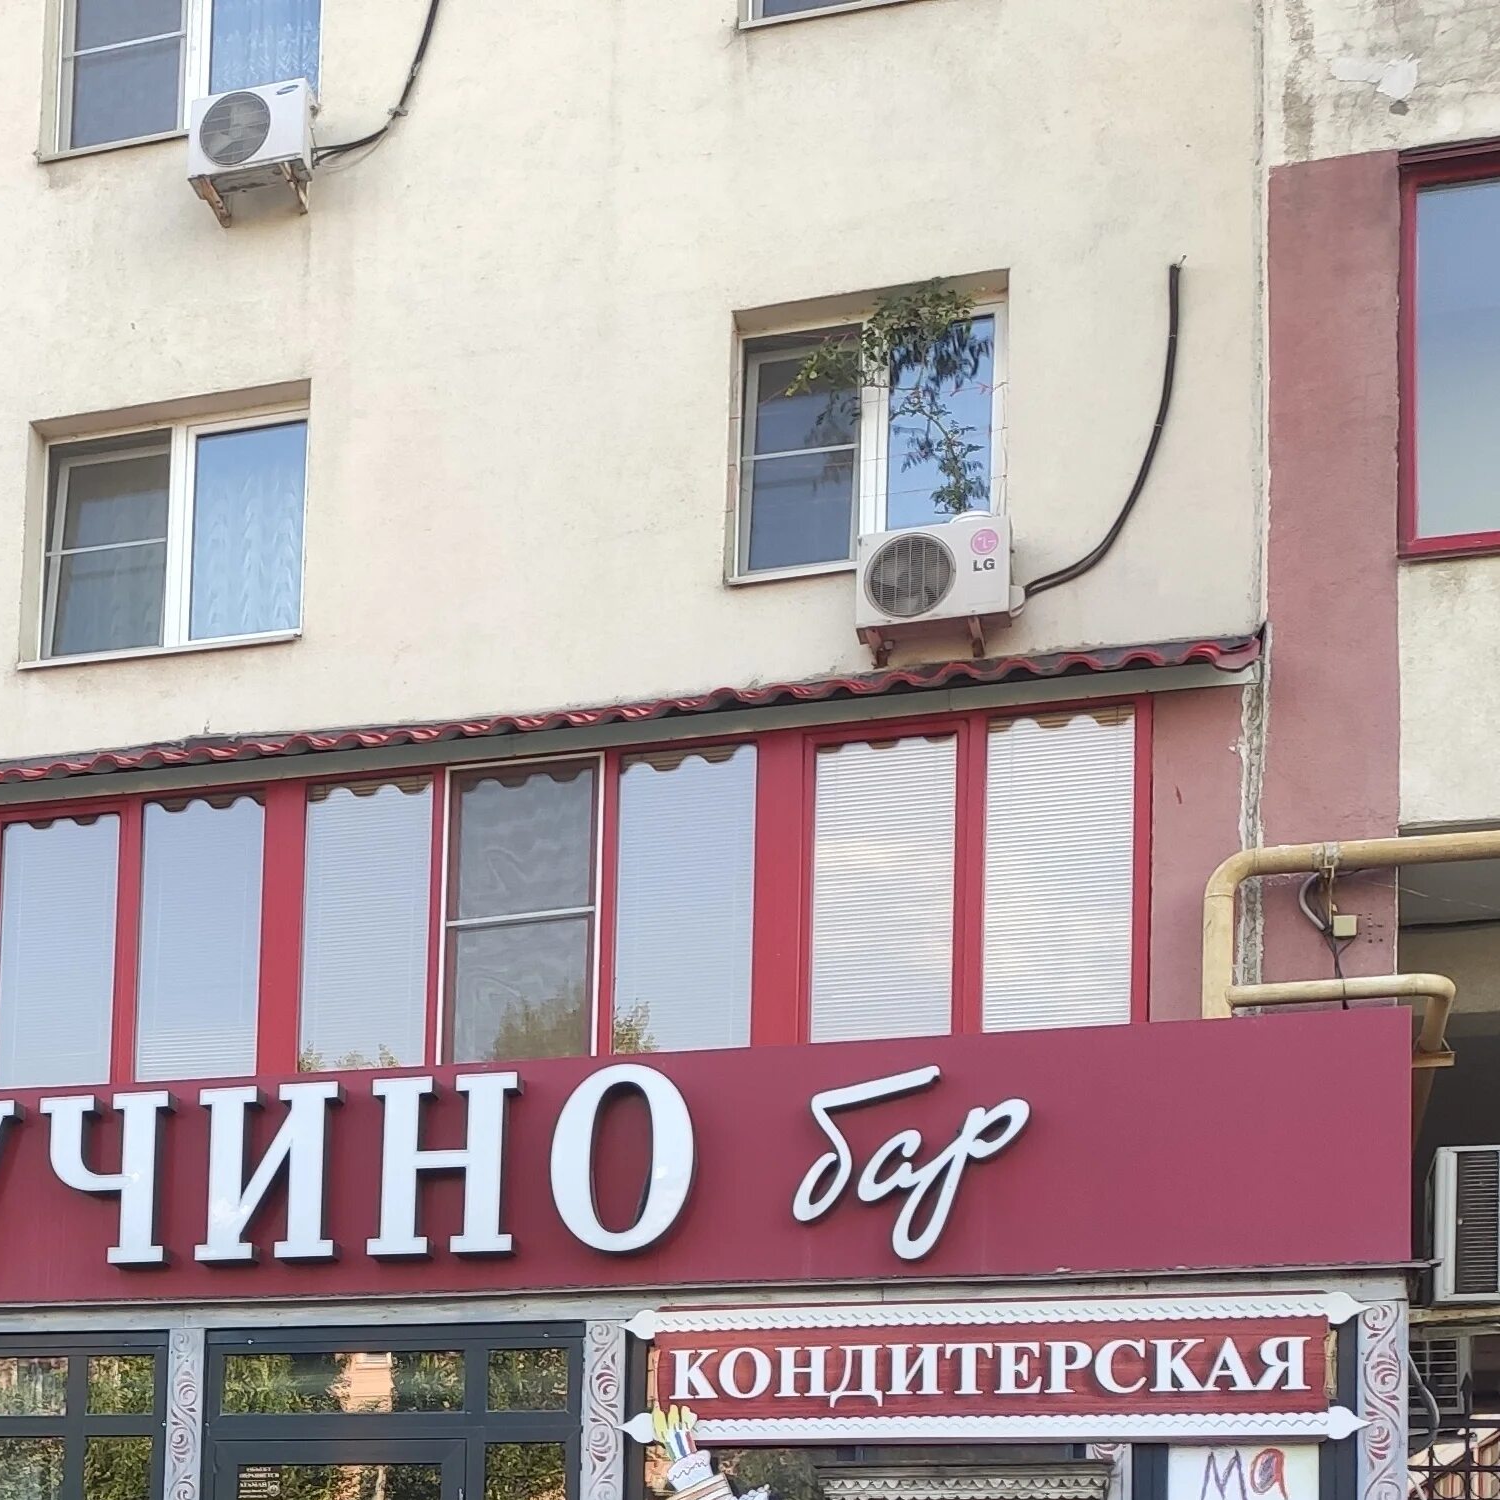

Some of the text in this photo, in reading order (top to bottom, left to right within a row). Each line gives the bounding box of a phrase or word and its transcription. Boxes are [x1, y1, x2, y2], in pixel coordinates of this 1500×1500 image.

[973, 558, 995, 571] LG
[791, 1065, 1031, 1262] бар
[668, 1336, 1312, 1409] КОНДИТЕРСКАЯ
